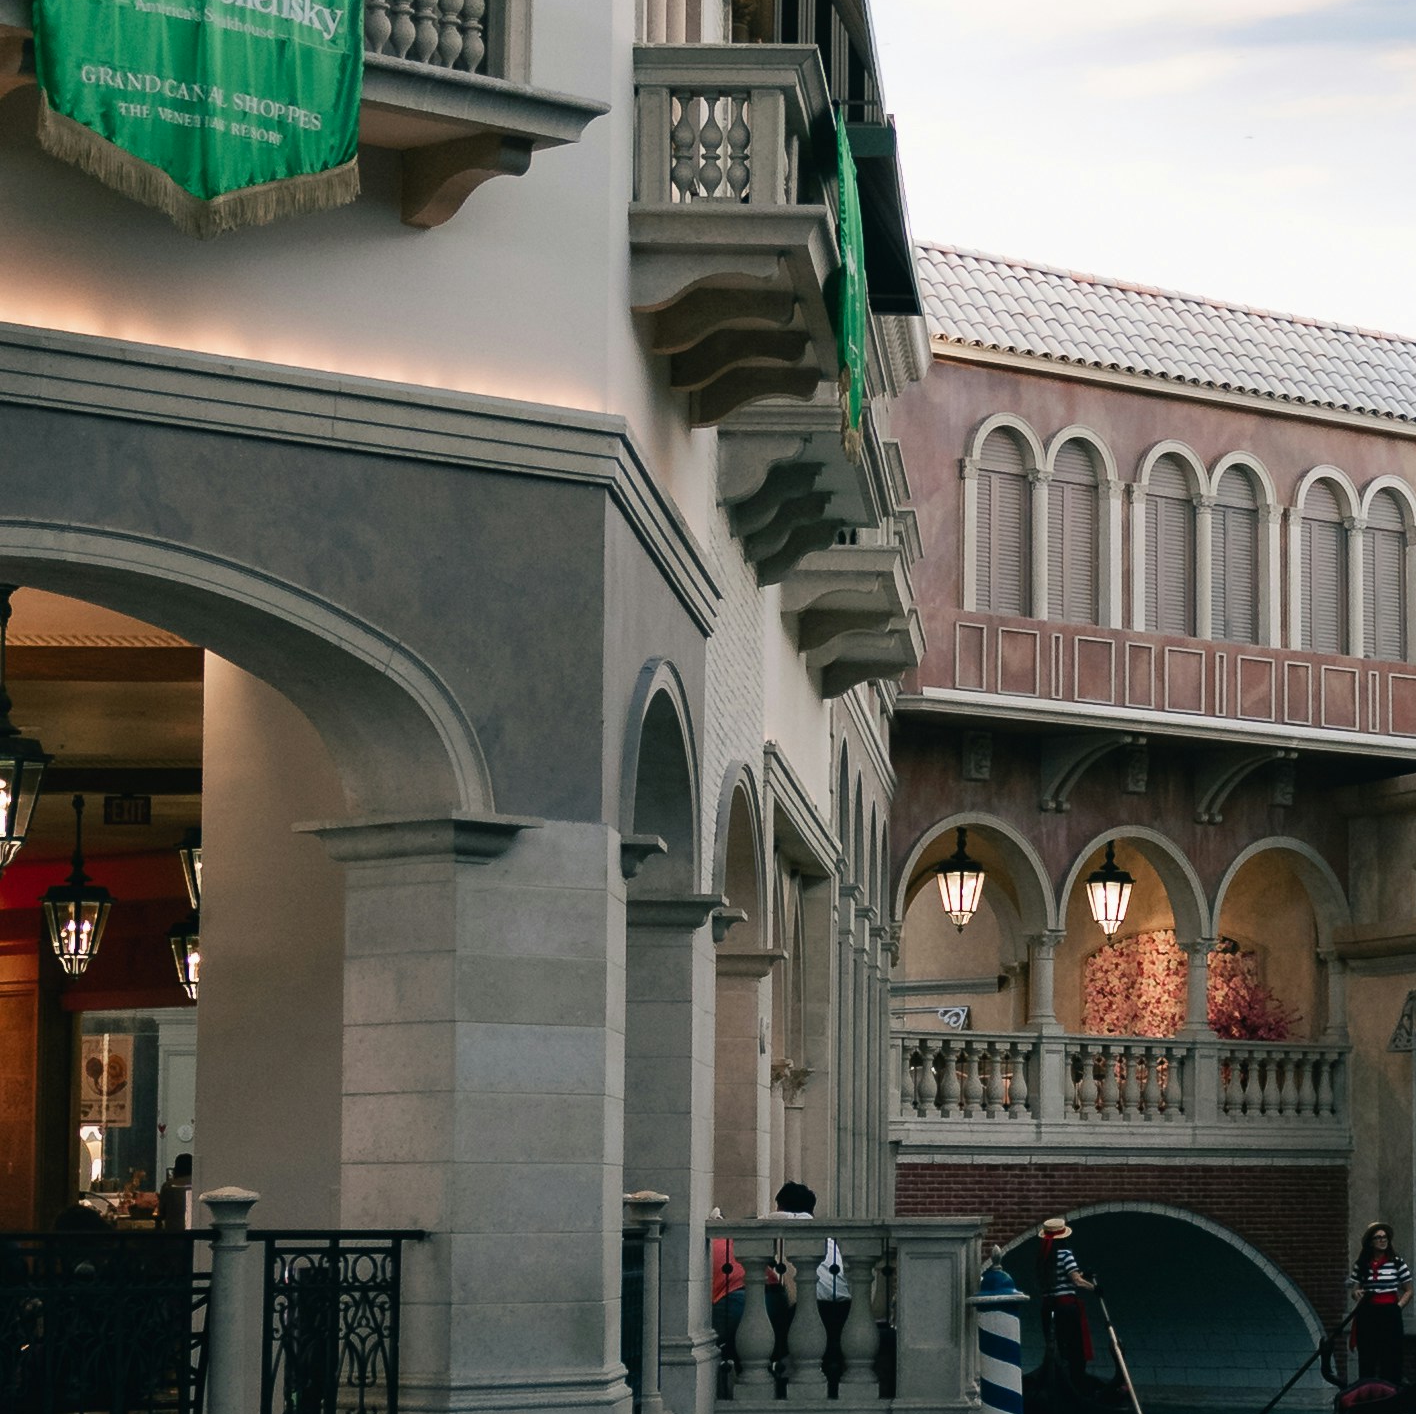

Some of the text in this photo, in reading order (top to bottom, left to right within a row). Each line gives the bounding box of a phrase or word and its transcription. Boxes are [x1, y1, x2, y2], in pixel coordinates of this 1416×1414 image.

[80, 64, 323, 132] GRAND CANAL SHOPPES
[117, 101, 151, 119] THE
